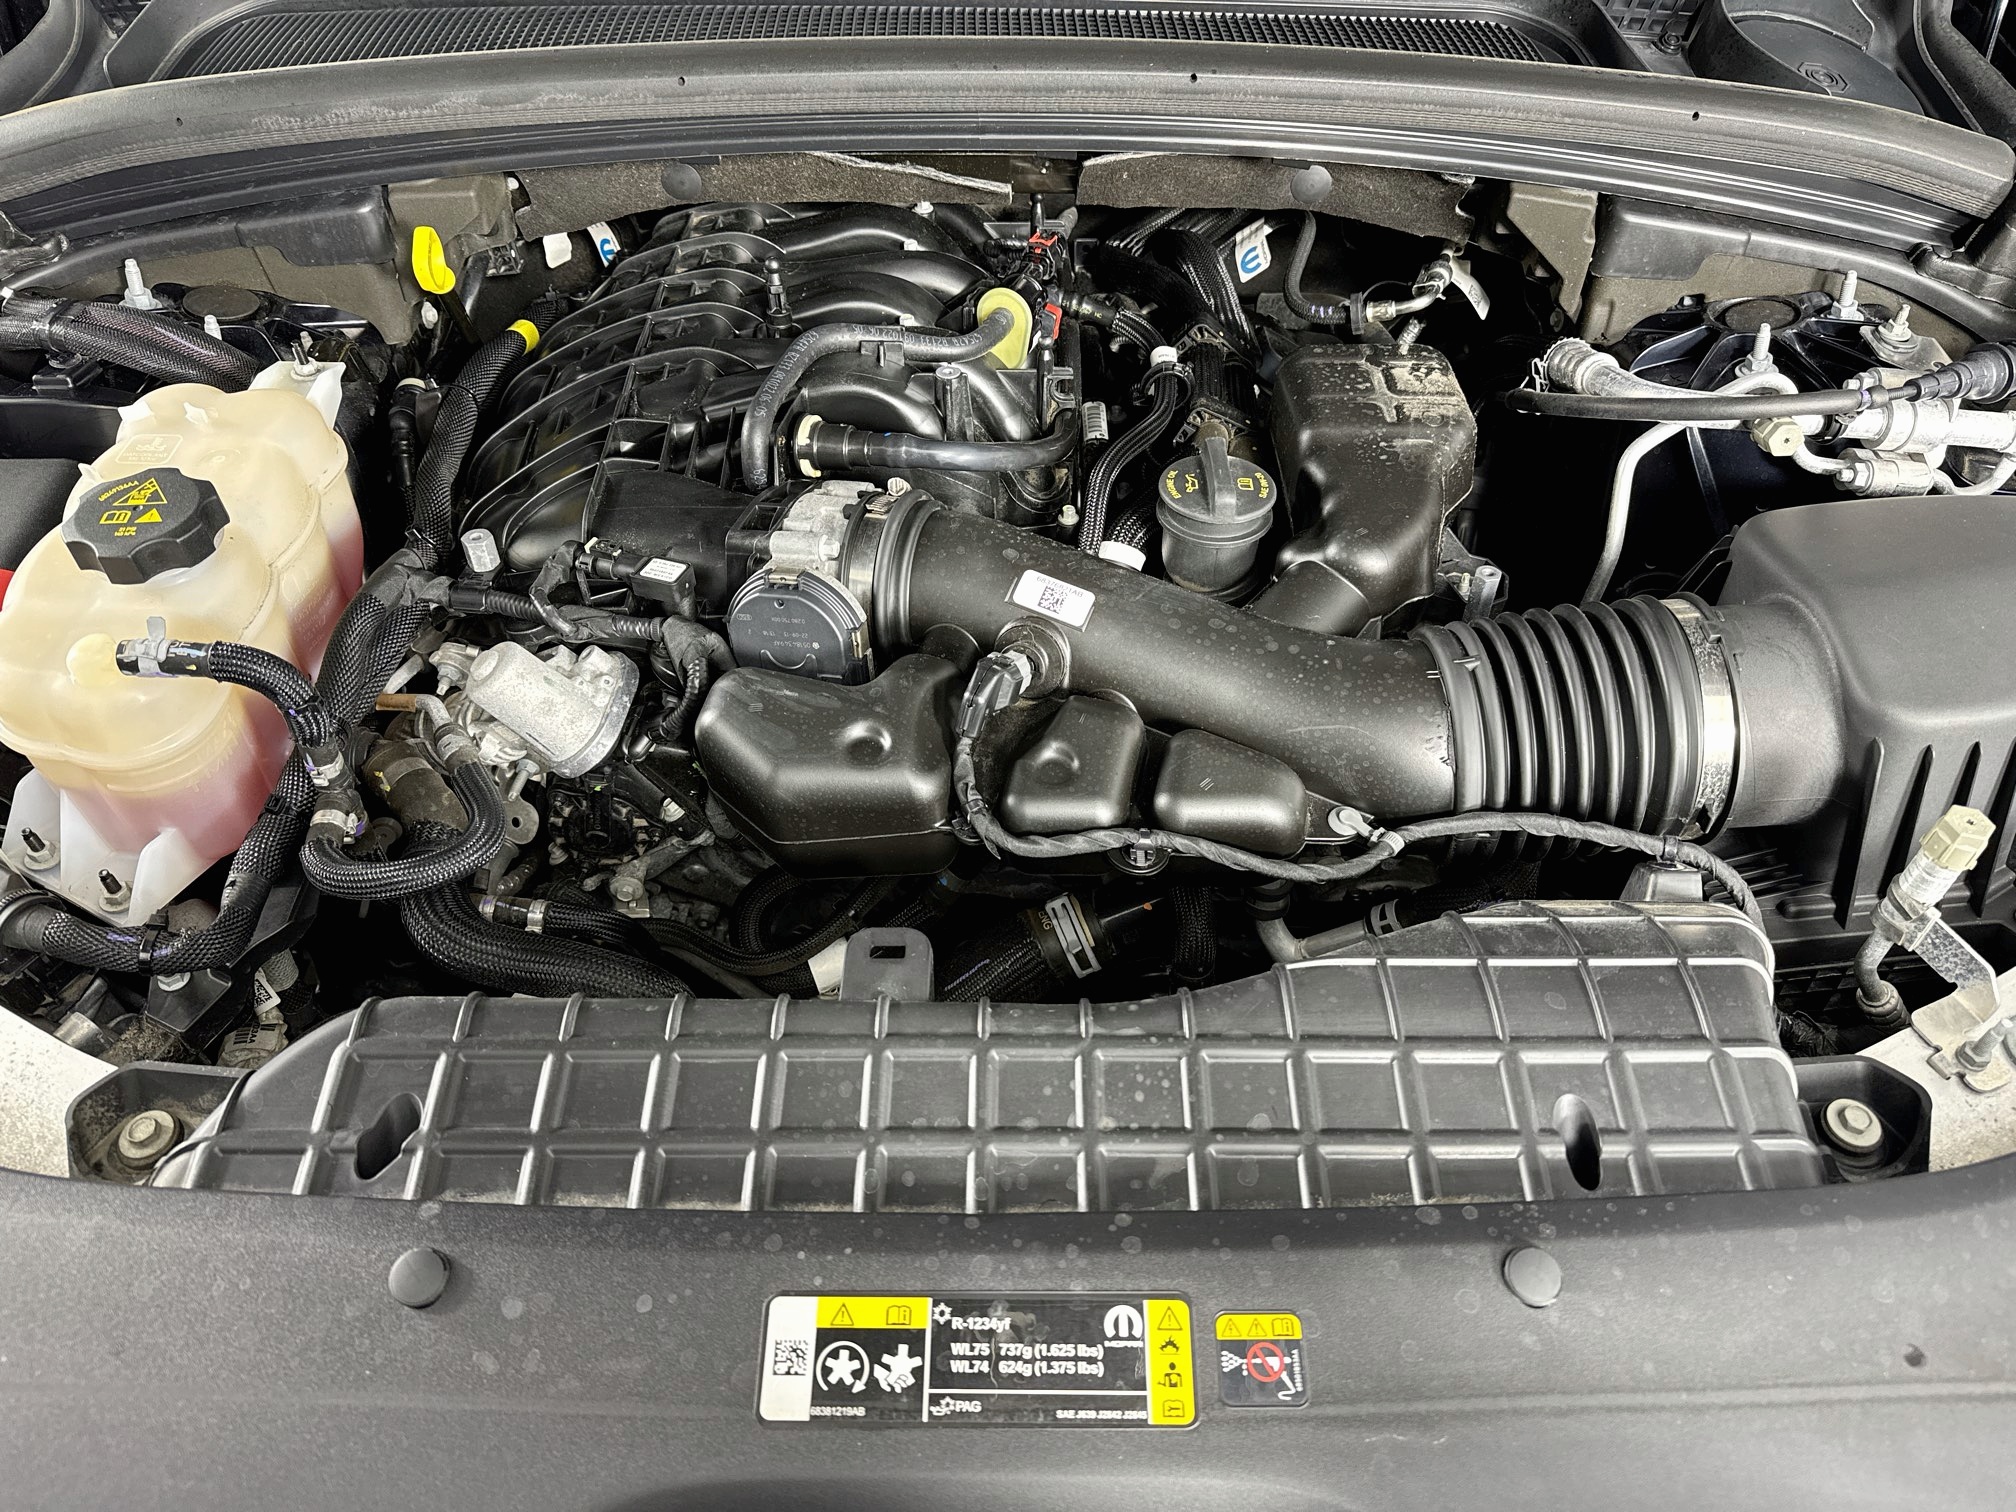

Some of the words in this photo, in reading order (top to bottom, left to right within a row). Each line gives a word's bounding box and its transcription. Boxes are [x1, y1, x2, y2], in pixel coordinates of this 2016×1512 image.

[951, 1316, 1012, 1333] R-1234yf
[950, 1342, 990, 1356] WL75
[998, 1343, 1033, 1360] 737g
[1034, 1343, 1076, 1360] (1.625
[1077, 1343, 1104, 1360] lbs)
[950, 1360, 990, 1373] WL74
[998, 1360, 1033, 1377] 624g
[1034, 1360, 1077, 1377] (1.375
[1077, 1360, 1105, 1378] lbs)
[955, 1400, 982, 1413] PAG
